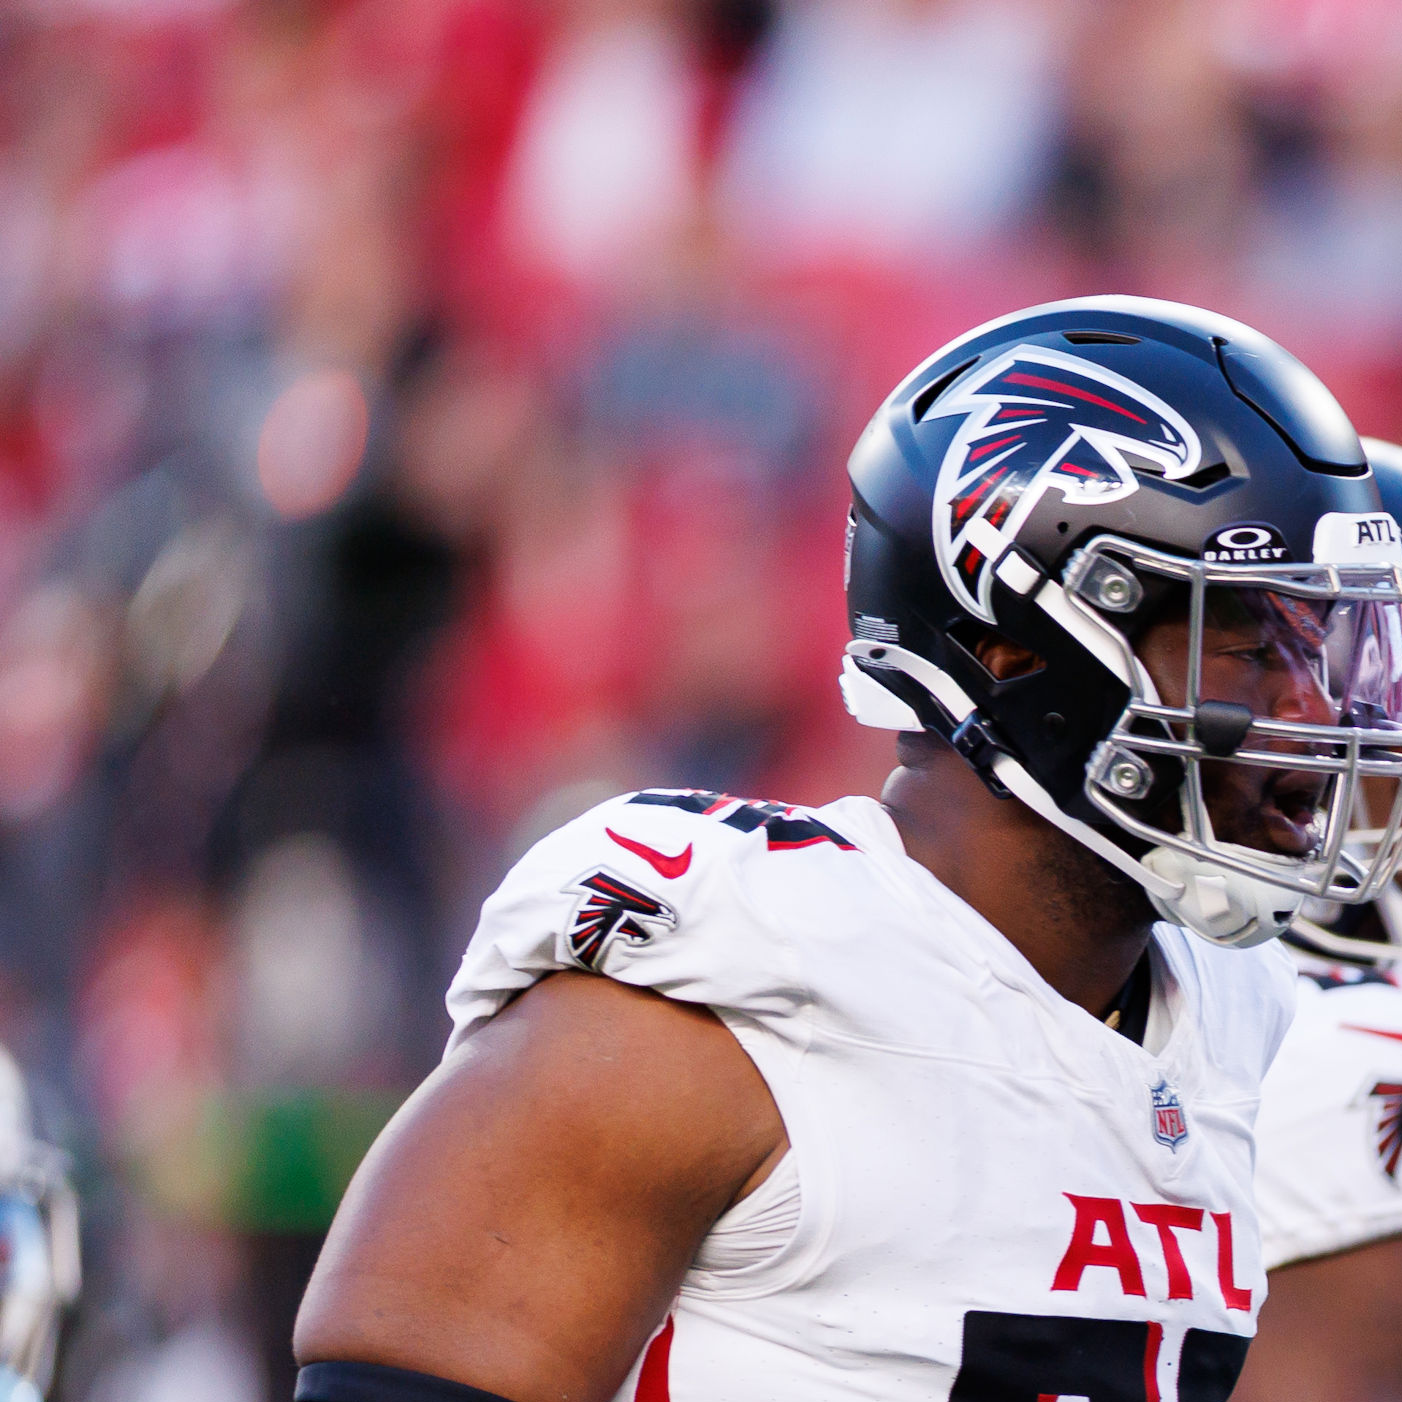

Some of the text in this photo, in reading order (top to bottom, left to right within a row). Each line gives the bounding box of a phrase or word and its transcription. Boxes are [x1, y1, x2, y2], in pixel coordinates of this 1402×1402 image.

[1356, 519, 1396, 545] ATL
[1204, 547, 1287, 562] OAKLEY
[1156, 1108, 1186, 1138] NFL
[1050, 1191, 1253, 1313] ATL
